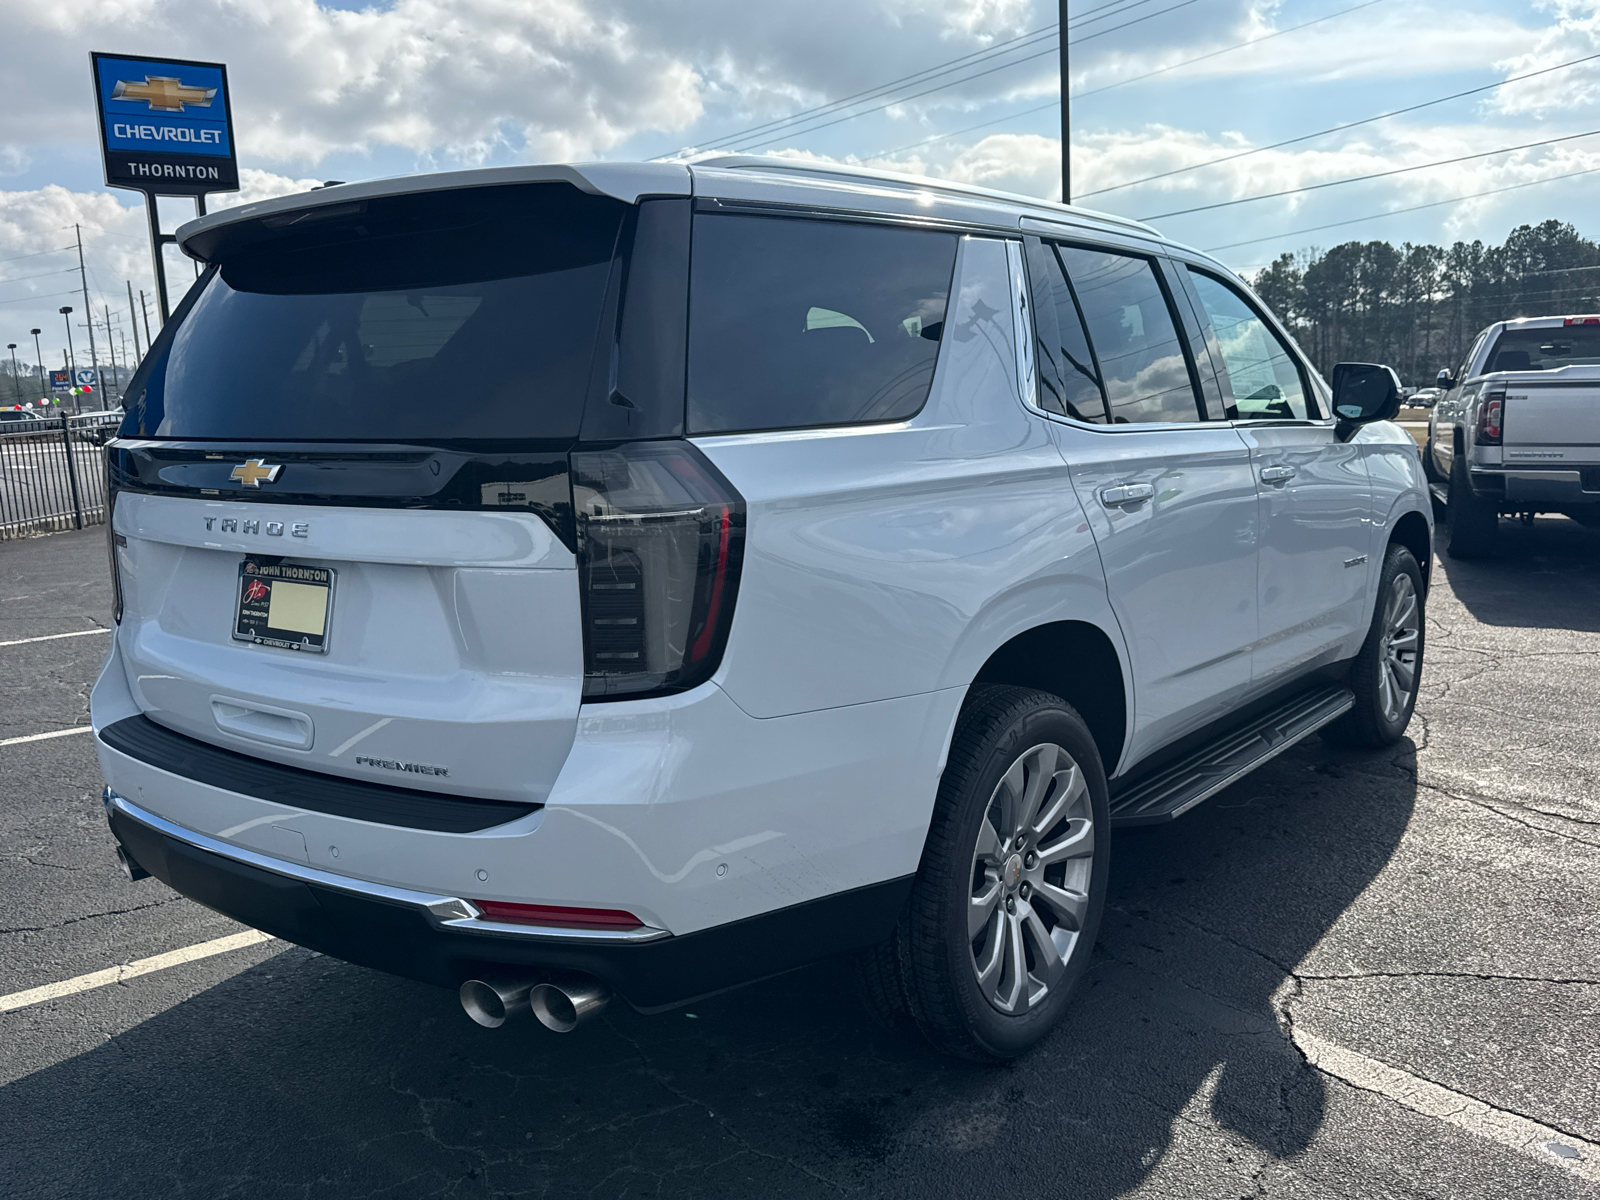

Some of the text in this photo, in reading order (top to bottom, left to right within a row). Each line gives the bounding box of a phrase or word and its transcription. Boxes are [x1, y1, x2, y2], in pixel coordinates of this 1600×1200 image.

[113, 123, 222, 144] CHEVROLET
[127, 162, 219, 180] THORNTON
[203, 516, 310, 539] TAHOE
[260, 565, 328, 582] JOHN THORNTON
[355, 756, 451, 777] PREMIER
